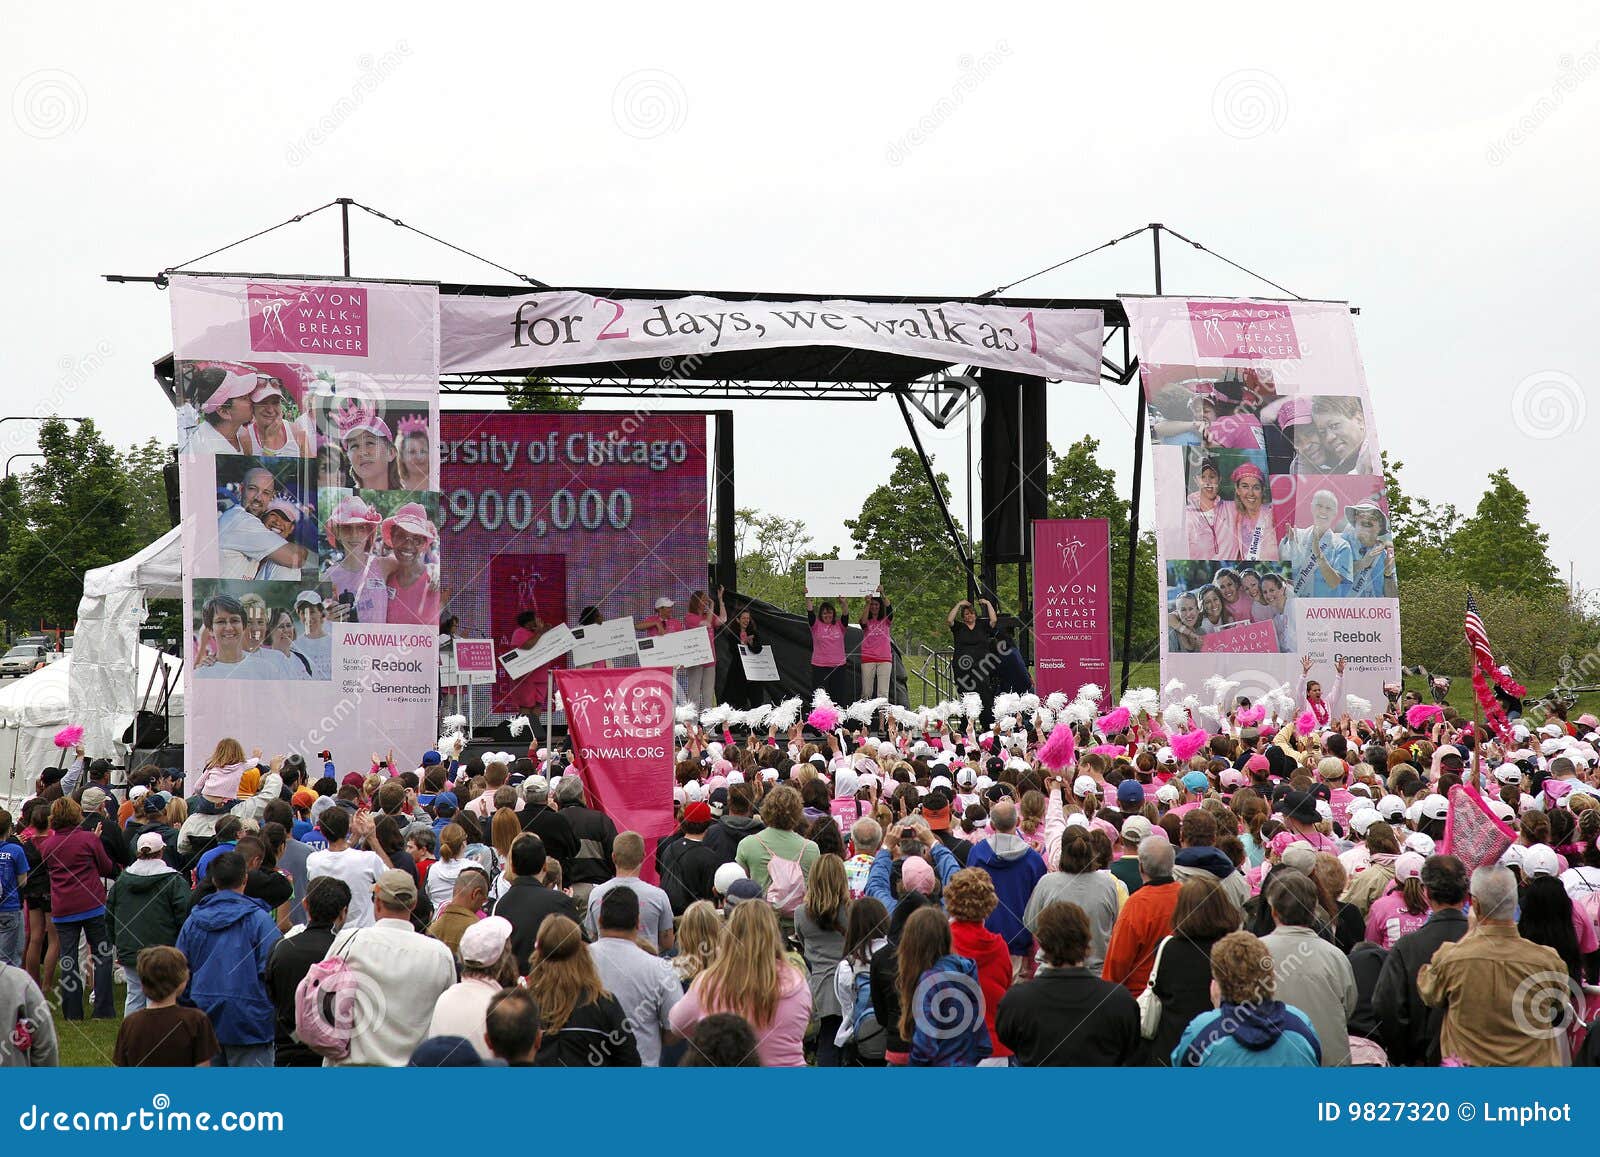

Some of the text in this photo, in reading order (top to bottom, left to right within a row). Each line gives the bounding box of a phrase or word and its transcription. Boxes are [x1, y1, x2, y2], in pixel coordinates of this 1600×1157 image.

[298, 293, 361, 306] AVON
[299, 308, 348, 320] WALK
[1231, 308, 1286, 319] AVON
[299, 323, 362, 335] BREAST
[510, 298, 1039, 355] for 2 days, we walk as 1
[1233, 321, 1277, 331] WALK
[1236, 333, 1291, 343] BREAST
[300, 338, 362, 351] CANCER
[1239, 345, 1295, 355] CANCER
[527, 432, 558, 463] of
[565, 432, 688, 471] Chicago
[1047, 584, 1096, 593] AVON
[1047, 597, 1086, 605] WALK
[1046, 608, 1097, 617] BREAST
[1306, 607, 1392, 620] AVONWALK.ORG
[1047, 620, 1097, 628] CANCER
[343, 633, 433, 648] AVONWALK.ORG
[1231, 630, 1268, 644] AVON
[1333, 631, 1382, 643] Reebok
[1232, 642, 1262, 653] WALK
[1334, 653, 1392, 664] Genentech
[372, 659, 422, 673] Reebok
[372, 683, 431, 695] Genentech
[603, 686, 663, 698] AVON
[603, 701, 649, 711] WALK
[603, 714, 662, 725] BREAST
[603, 728, 662, 738] CANCER
